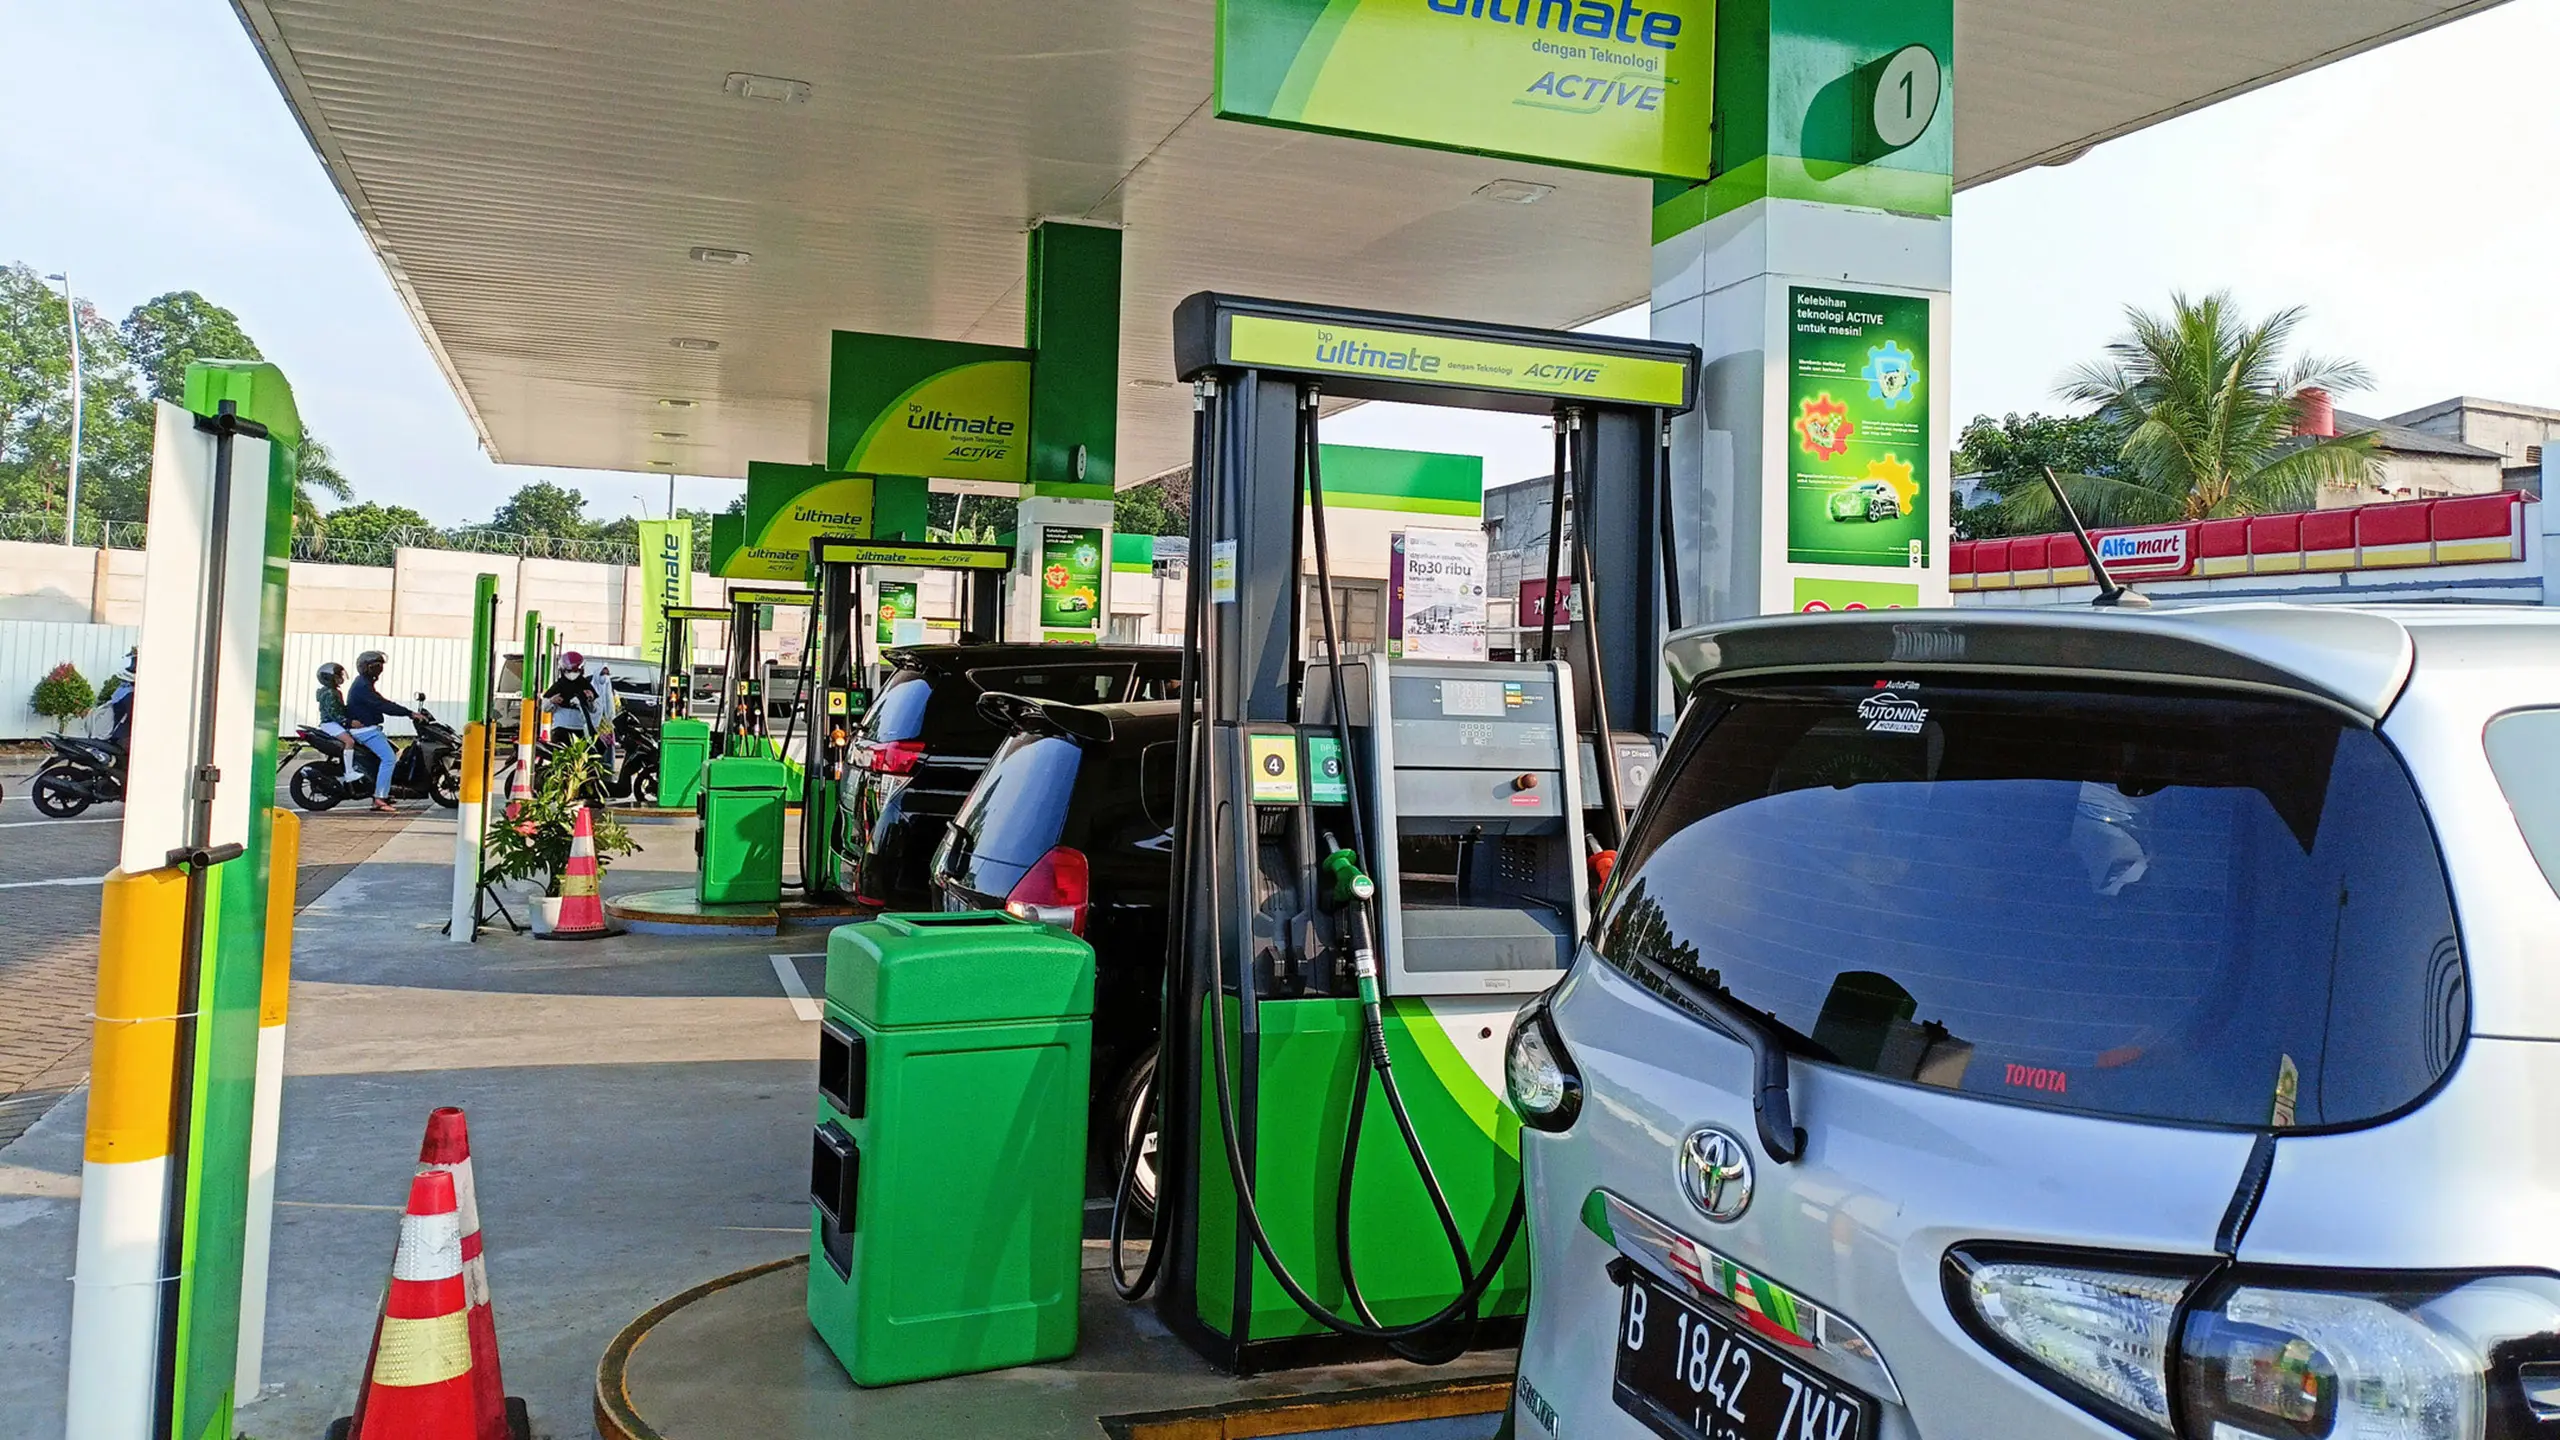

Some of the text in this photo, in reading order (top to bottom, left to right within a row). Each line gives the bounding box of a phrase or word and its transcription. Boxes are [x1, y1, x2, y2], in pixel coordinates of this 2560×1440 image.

[1532, 39, 1659, 73] dengan Teknologi
[1526, 71, 1665, 111] ACTIVE
[1899, 70, 1913, 119] 1
[1797, 294, 1847, 308] Kelebihan
[1797, 309, 1884, 325] teknologi ACTIVE
[1317, 329, 1333, 343] bp
[1797, 323, 1826, 334] untuk
[1316, 340, 1600, 383] ultimate dengan Teknologi ACTIVE
[909, 402, 922, 413] bp
[907, 410, 1015, 436] ultimate
[948, 446, 1007, 460] ACTIVE
[794, 509, 863, 525] ultimate
[2101, 535, 2180, 557] Alfamart
[747, 549, 800, 561] ultimate
[856, 549, 907, 563] ultimate
[1409, 560, 1472, 576] Rp30 ribu
[1885, 681, 1921, 690] AutoFilm
[1859, 706, 1929, 722] AUTONINE
[1879, 721, 1919, 731] MOBILINDO
[1268, 758, 1280, 772] 4
[1327, 760, 1337, 774] 3
[2005, 1063, 2067, 1093] TOYOTA
[1627, 1283, 1648, 1351] B
[1676, 1312, 1751, 1424] 1842
